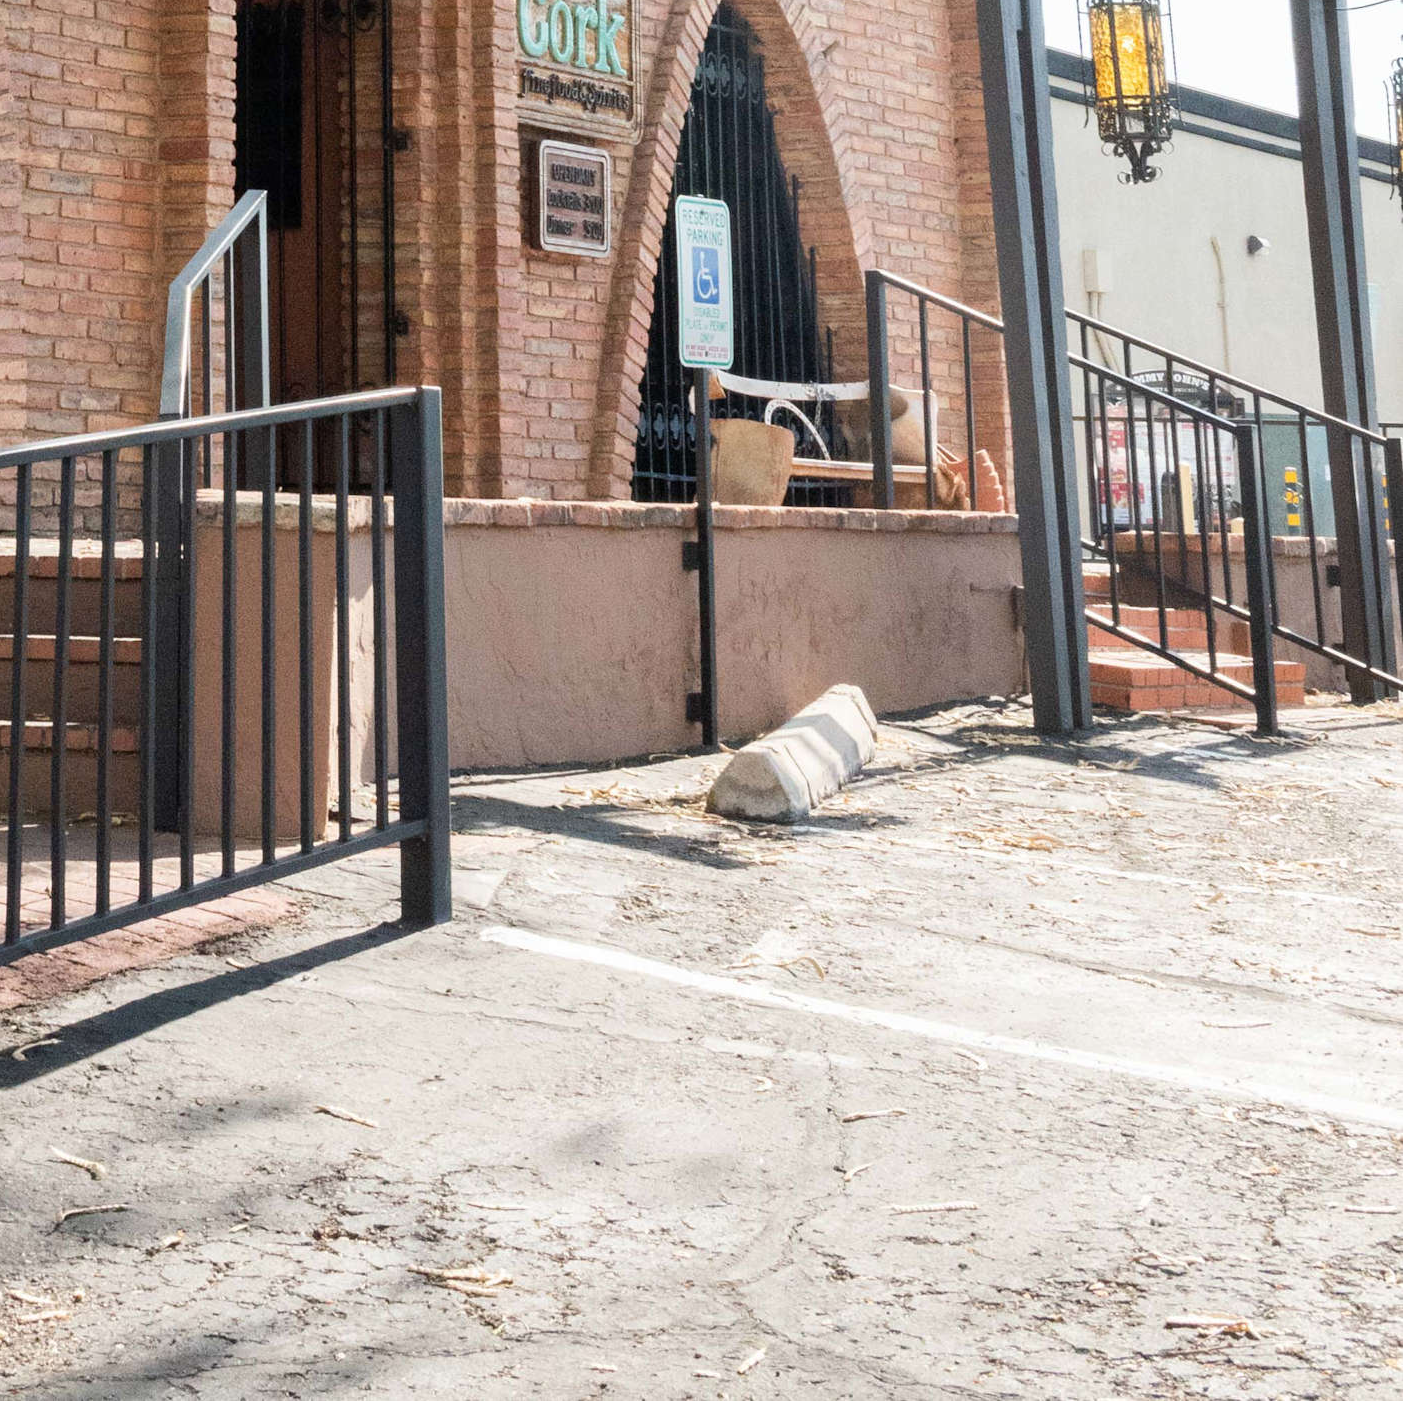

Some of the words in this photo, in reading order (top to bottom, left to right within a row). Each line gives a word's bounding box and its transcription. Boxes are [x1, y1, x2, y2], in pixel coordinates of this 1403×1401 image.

[682, 209, 725, 227] RESERVED
[686, 227, 723, 246] PARKING
[1174, 373, 1210, 391] OHN'S
